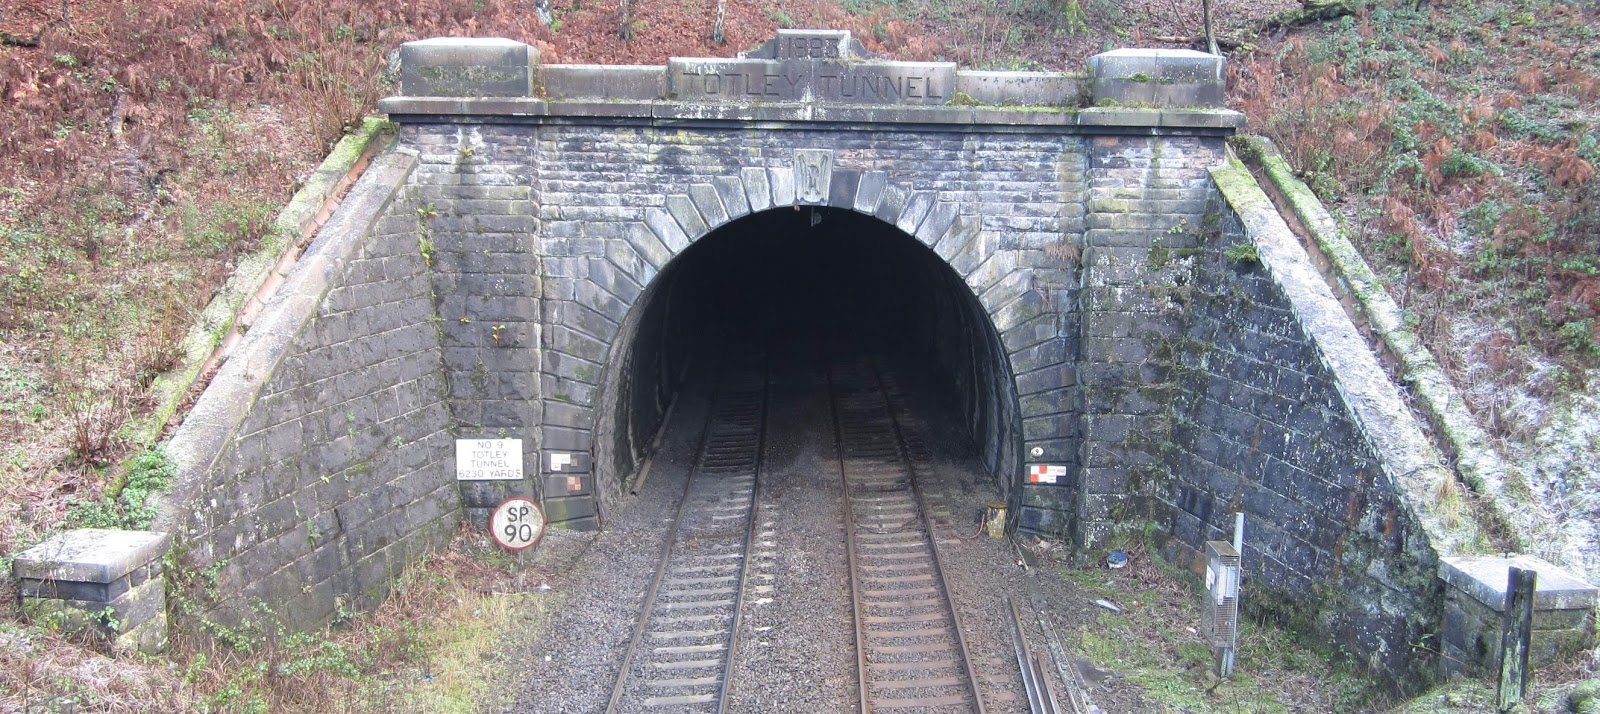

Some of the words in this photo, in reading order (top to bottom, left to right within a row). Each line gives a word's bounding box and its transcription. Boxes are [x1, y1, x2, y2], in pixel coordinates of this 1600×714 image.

[682, 72, 803, 97] TOTLEY
[820, 75, 943, 99] TUNNEL
[477, 441, 492, 449] NO
[497, 441, 503, 449] 9
[472, 450, 508, 459] TOTLEY
[471, 460, 510, 468] TUNNEL
[458, 469, 484, 478] 6230
[490, 469, 521, 478] YARDS
[507, 506, 529, 522] SP
[504, 523, 532, 543] 90
